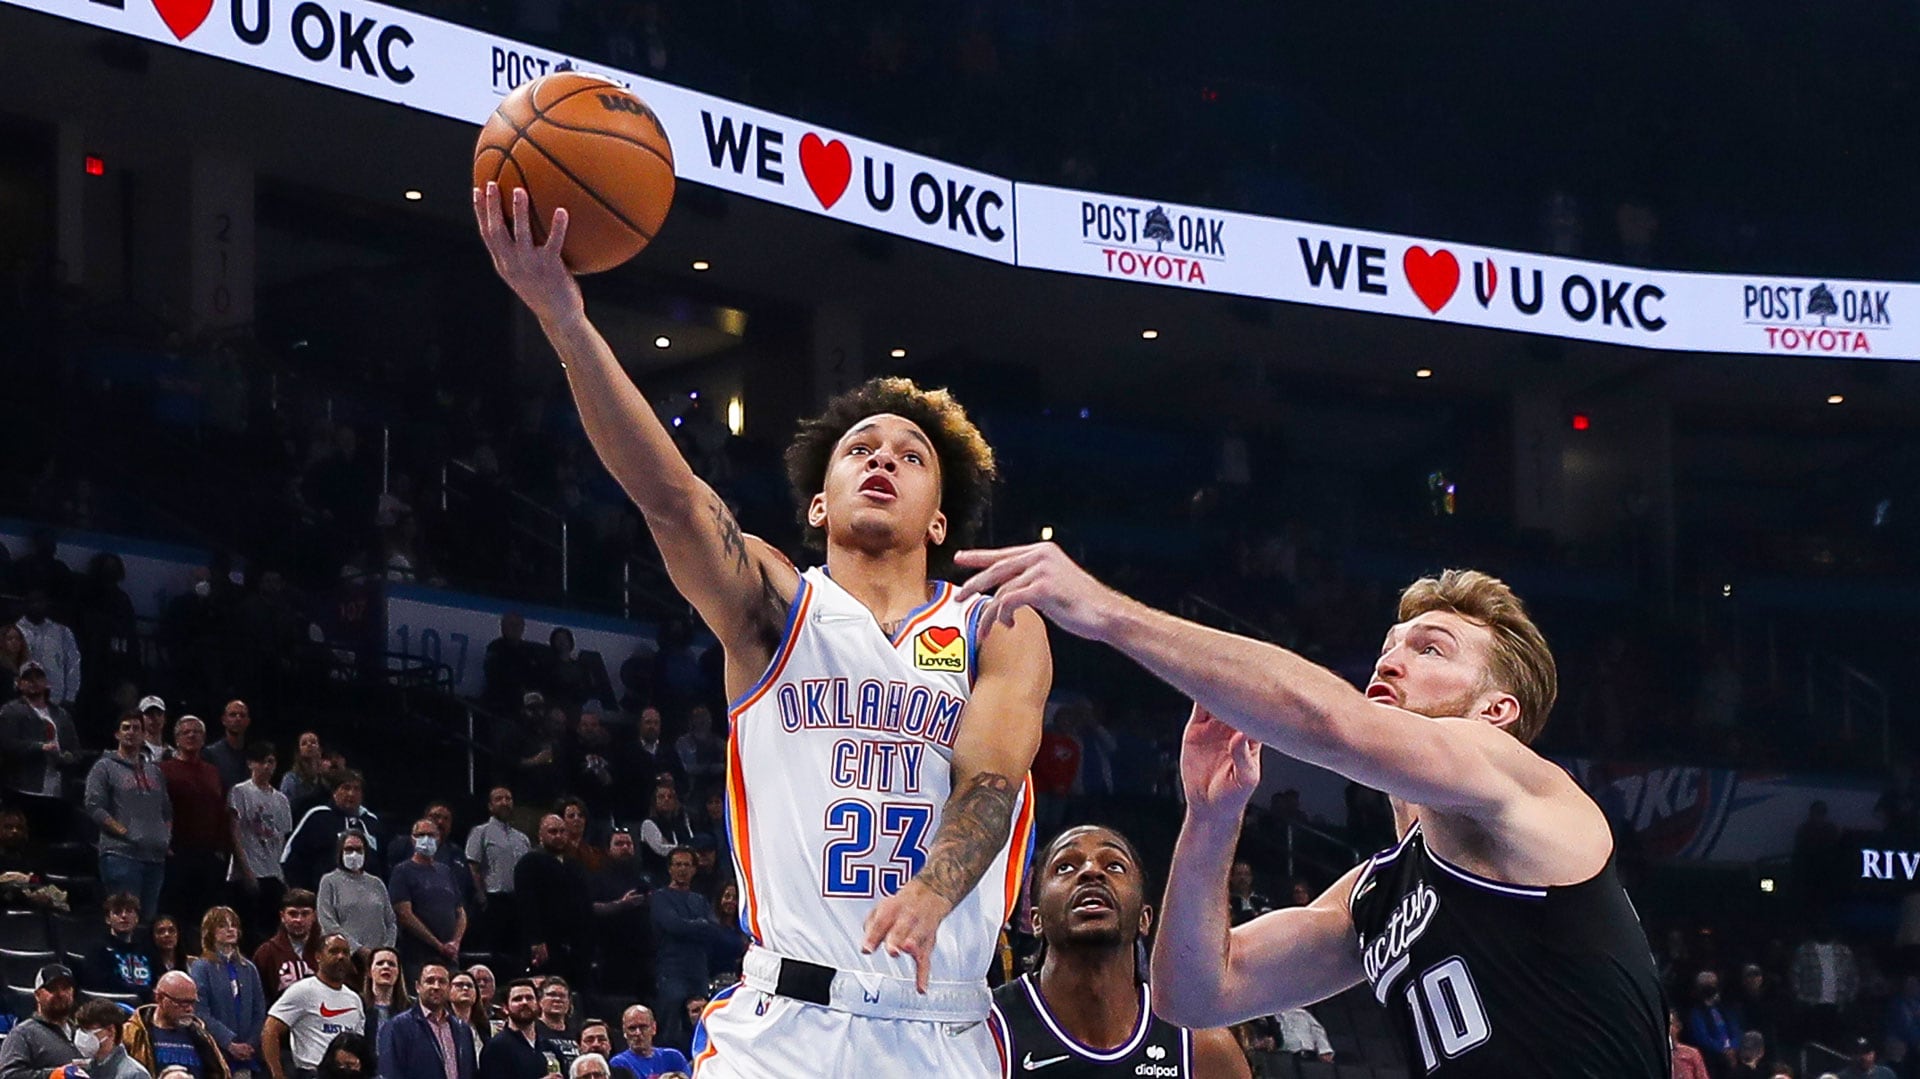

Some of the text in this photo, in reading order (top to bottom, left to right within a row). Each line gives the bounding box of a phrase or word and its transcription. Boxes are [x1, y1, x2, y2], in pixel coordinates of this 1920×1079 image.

[230, 0, 416, 85] U OKC
[700, 109, 785, 186] WE
[863, 155, 895, 213] U
[909, 171, 1006, 243] OKC
[1081, 201, 1226, 257] POST OAK
[1102, 248, 1207, 285] TOYOTA
[1297, 237, 1388, 296] WE
[1509, 266, 1544, 316] U
[1560, 274, 1668, 333] OKC
[1744, 284, 1891, 325] POST OAK
[1764, 327, 1871, 353] TOYOTA
[777, 677, 967, 749] OKLAHOM
[830, 738, 925, 793] CITY
[822, 797, 934, 899] 23
[1404, 954, 1492, 1075] 10
